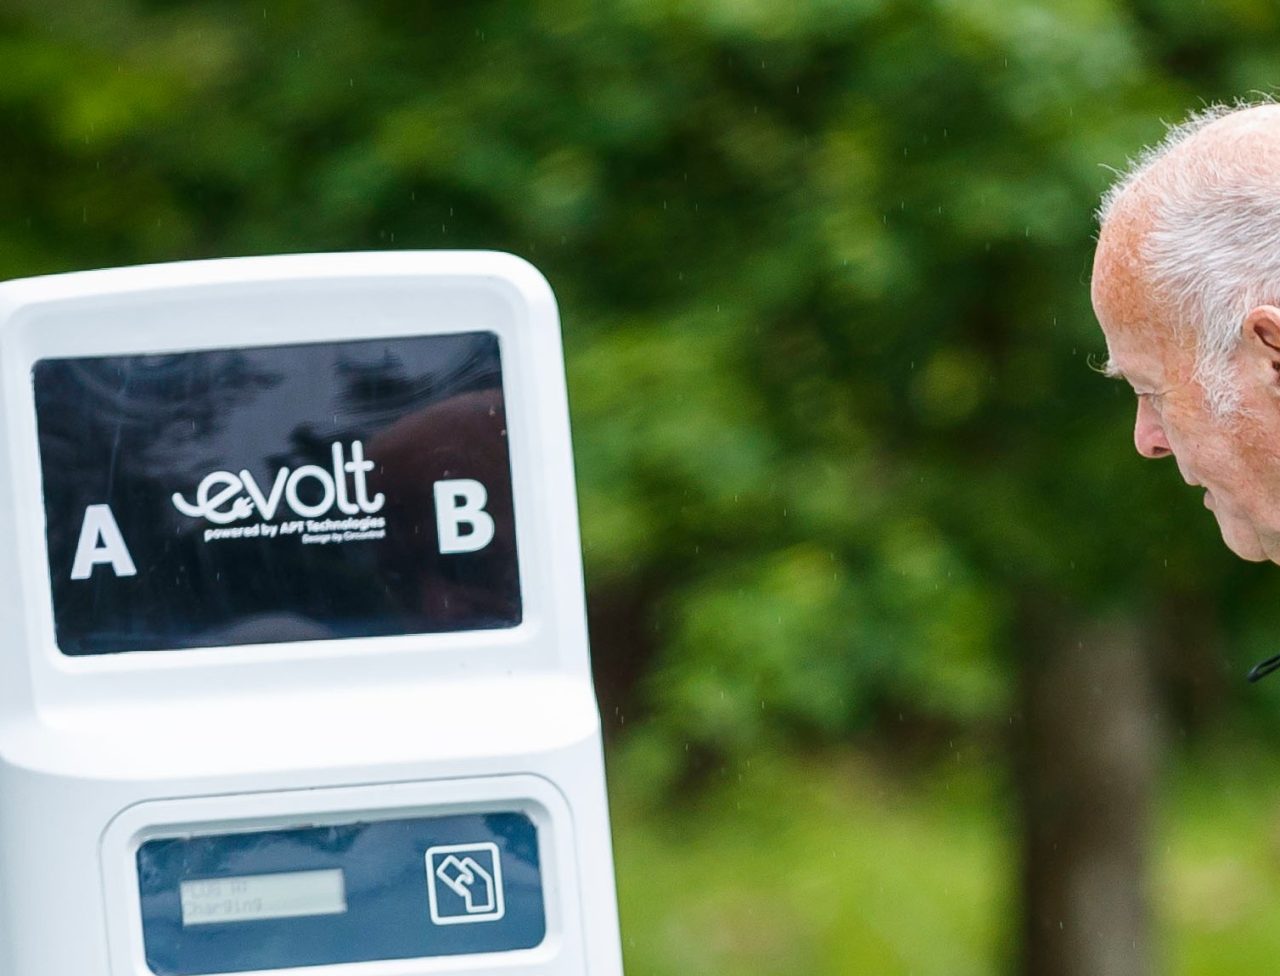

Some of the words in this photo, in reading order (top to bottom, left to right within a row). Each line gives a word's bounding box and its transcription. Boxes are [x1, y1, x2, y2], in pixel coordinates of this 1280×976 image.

[172, 440, 385, 524] evolt
[433, 479, 495, 554] B
[70, 503, 137, 580] A
[204, 523, 260, 542] powered
[261, 523, 278, 538] by
[280, 520, 305, 534] APT
[306, 515, 386, 532] Technologies
